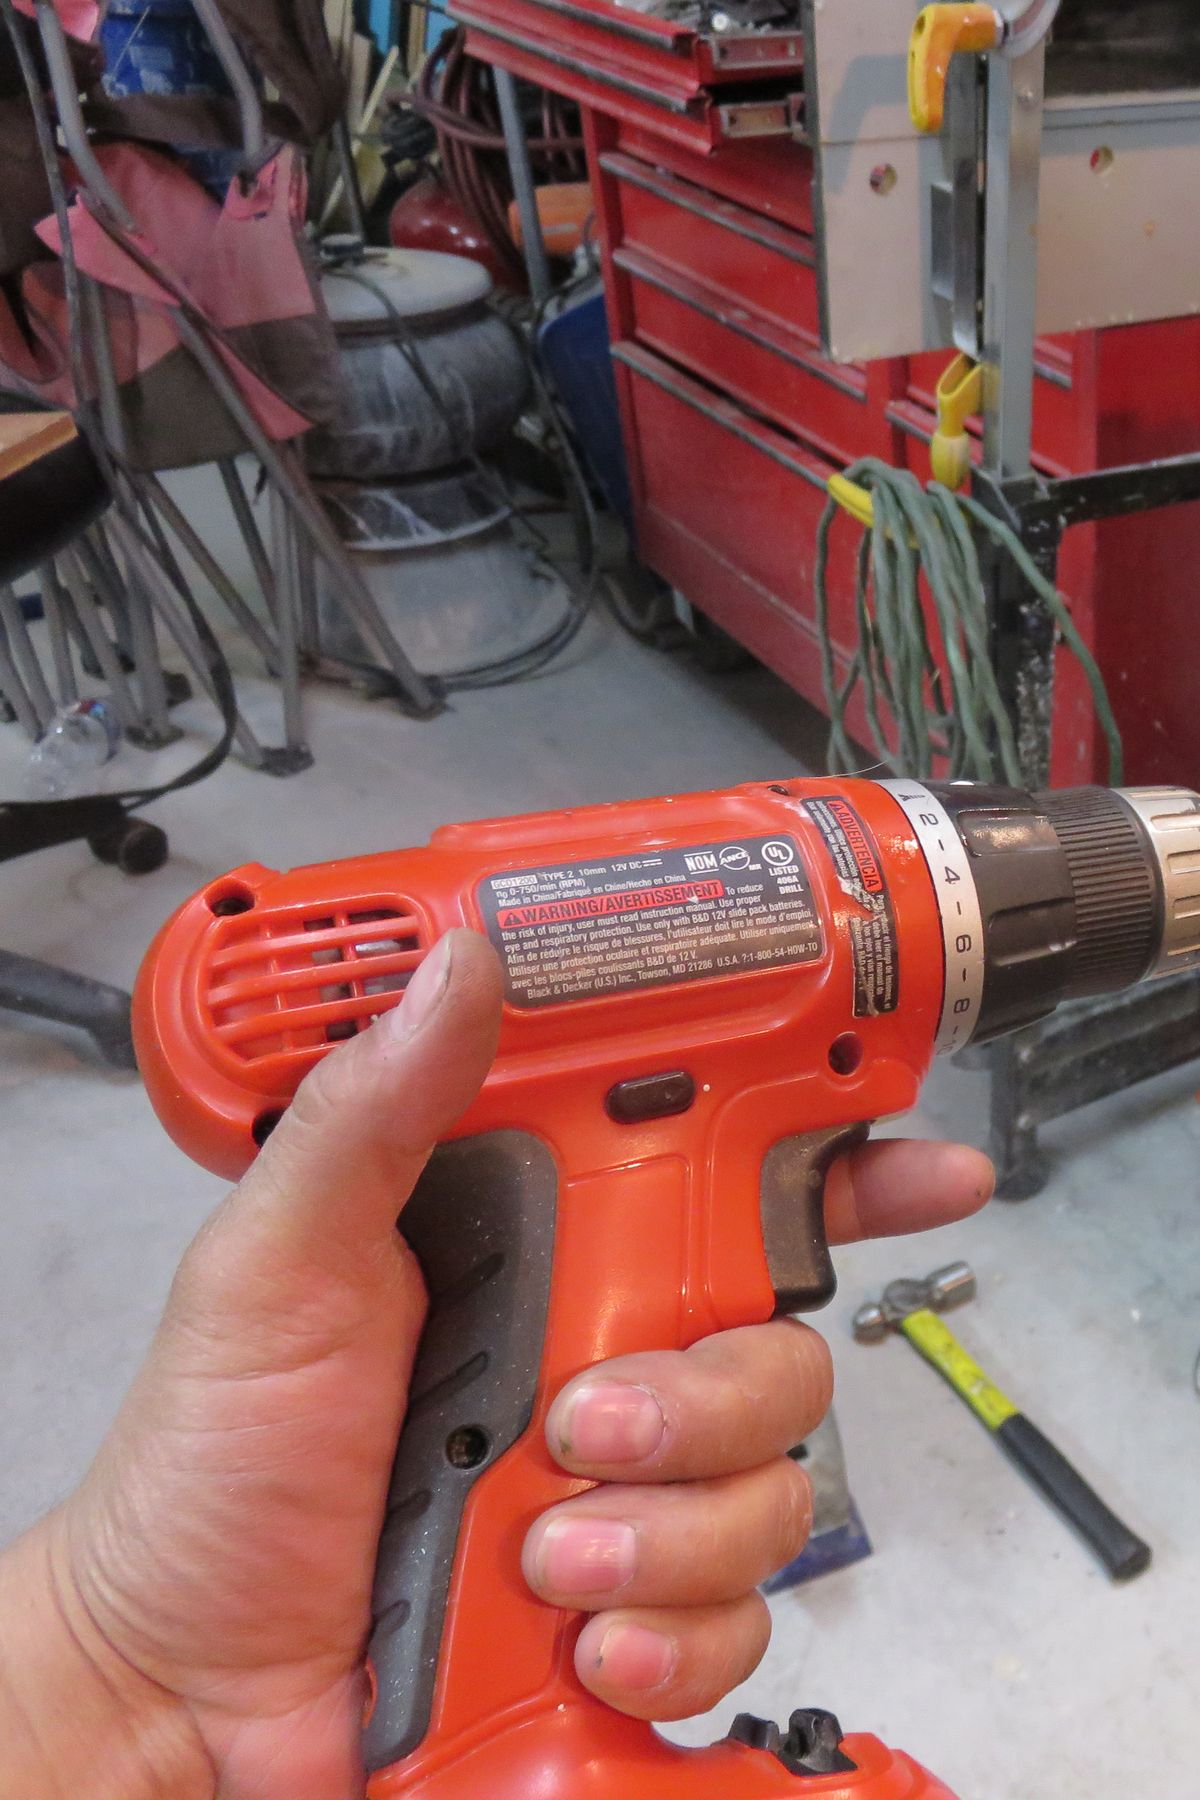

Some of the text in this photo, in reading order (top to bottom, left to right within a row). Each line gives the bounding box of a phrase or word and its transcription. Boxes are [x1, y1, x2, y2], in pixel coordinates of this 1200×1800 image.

[919, 813, 939, 826] 2
[836, 811, 880, 888] ADVERTENCIA
[684, 854, 717, 871] NOM
[720, 852, 749, 866] ANCE
[543, 871, 565, 880] TYPE
[579, 866, 606, 875] 10mm
[611, 863, 626, 871] 12V
[769, 864, 798, 876] LISTED
[943, 866, 960, 884] 4
[509, 882, 556, 895] 0-750/min
[558, 878, 585, 889] (RPM)
[776, 875, 798, 884] 406A
[779, 883, 803, 894] DRILL
[498, 898, 520, 906] Made
[604, 878, 651, 891] Chine/Hecho
[664, 874, 685, 882] China
[521, 882, 763, 922] WARNING/AVERTISSEMENT To reduce
[502, 930, 516, 939] the
[518, 928, 534, 937] risk
[537, 926, 546, 934] of
[548, 922, 575, 934] injury,
[597, 916, 618, 925] must
[620, 912, 638, 922] read
[640, 905, 684, 919] instruction
[685, 901, 717, 912] manual.
[719, 898, 733, 907] Use
[736, 895, 762, 906] proper
[504, 899, 805, 953] eye and respiratory protection. Use only with B&D 12V slide pack batteries.
[506, 953, 524, 963] Afin
[526, 951, 537, 960] de
[572, 945, 580, 953] le
[582, 940, 609, 953] risque
[611, 938, 621, 947] de
[623, 931, 665, 946] blessures,
[667, 924, 712, 938] l'utilisateur
[713, 921, 729, 931] doit
[731, 919, 744, 928] lire
[745, 918, 753, 926] le
[755, 914, 776, 924] mode
[778, 908, 813, 922] d'emploi.
[955, 934, 971, 953] 6
[509, 963, 540, 976] Utiliser
[542, 962, 558, 970] une
[560, 953, 603, 969] protection
[605, 948, 639, 960] oculaire
[641, 946, 649, 954] et
[651, 938, 697, 954] respiratoire
[739, 927, 768, 938] Utiliser
[511, 979, 531, 988] avec
[534, 975, 547, 984] les
[549, 967, 596, 983] blocs-piles
[597, 959, 644, 974] coulissants
[646, 955, 664, 966] B&D
[666, 954, 676, 962] de
[679, 952, 688, 960] 12
[527, 986, 551, 998] Black
[553, 985, 560, 993] &
[562, 979, 592, 992] Decker
[594, 975, 616, 988] (U.S.)
[618, 972, 636, 984] Inc.,
[637, 966, 670, 980] Towson,
[672, 964, 685, 973] MD
[953, 997, 970, 1014] 8
